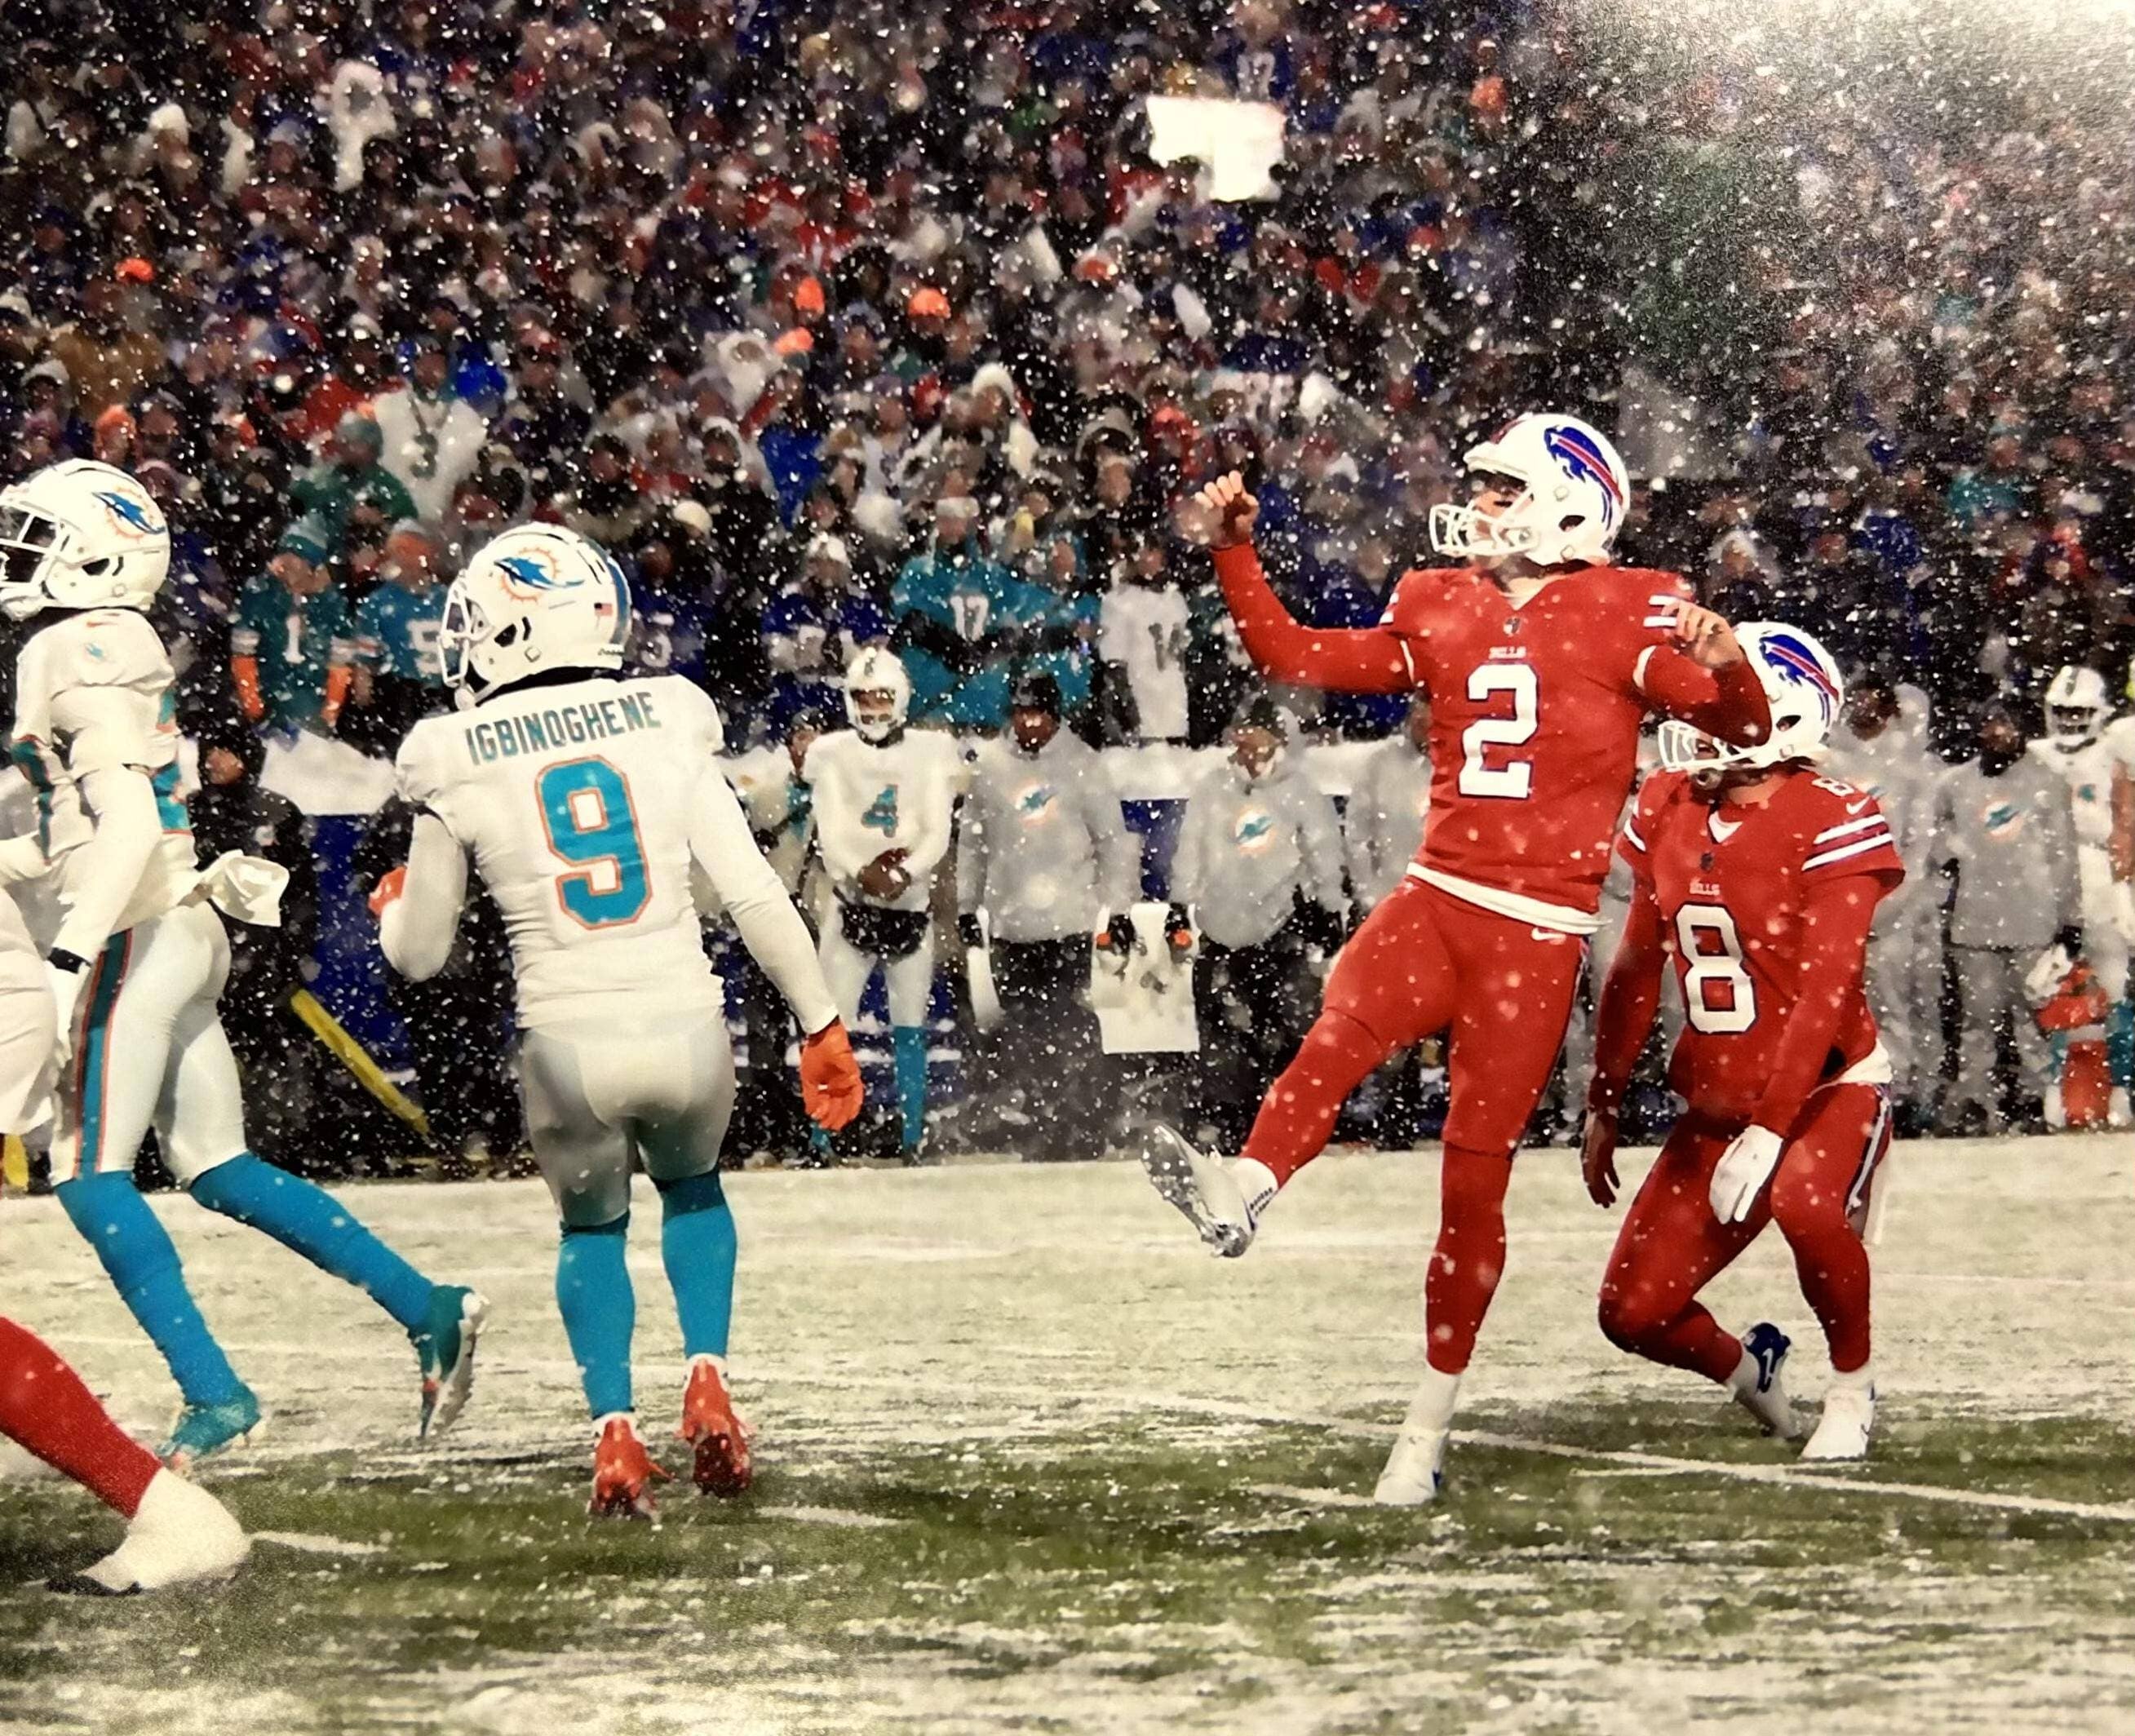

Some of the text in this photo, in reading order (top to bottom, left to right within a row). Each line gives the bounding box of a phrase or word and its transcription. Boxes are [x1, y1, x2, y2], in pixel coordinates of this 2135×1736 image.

[950, 595, 990, 642] 17
[466, 691, 662, 766] IGBINOGHENE
[1458, 662, 1539, 800] 2
[534, 754, 653, 930] 9
[861, 783, 898, 839] 4
[1675, 901, 1757, 1035] 8
